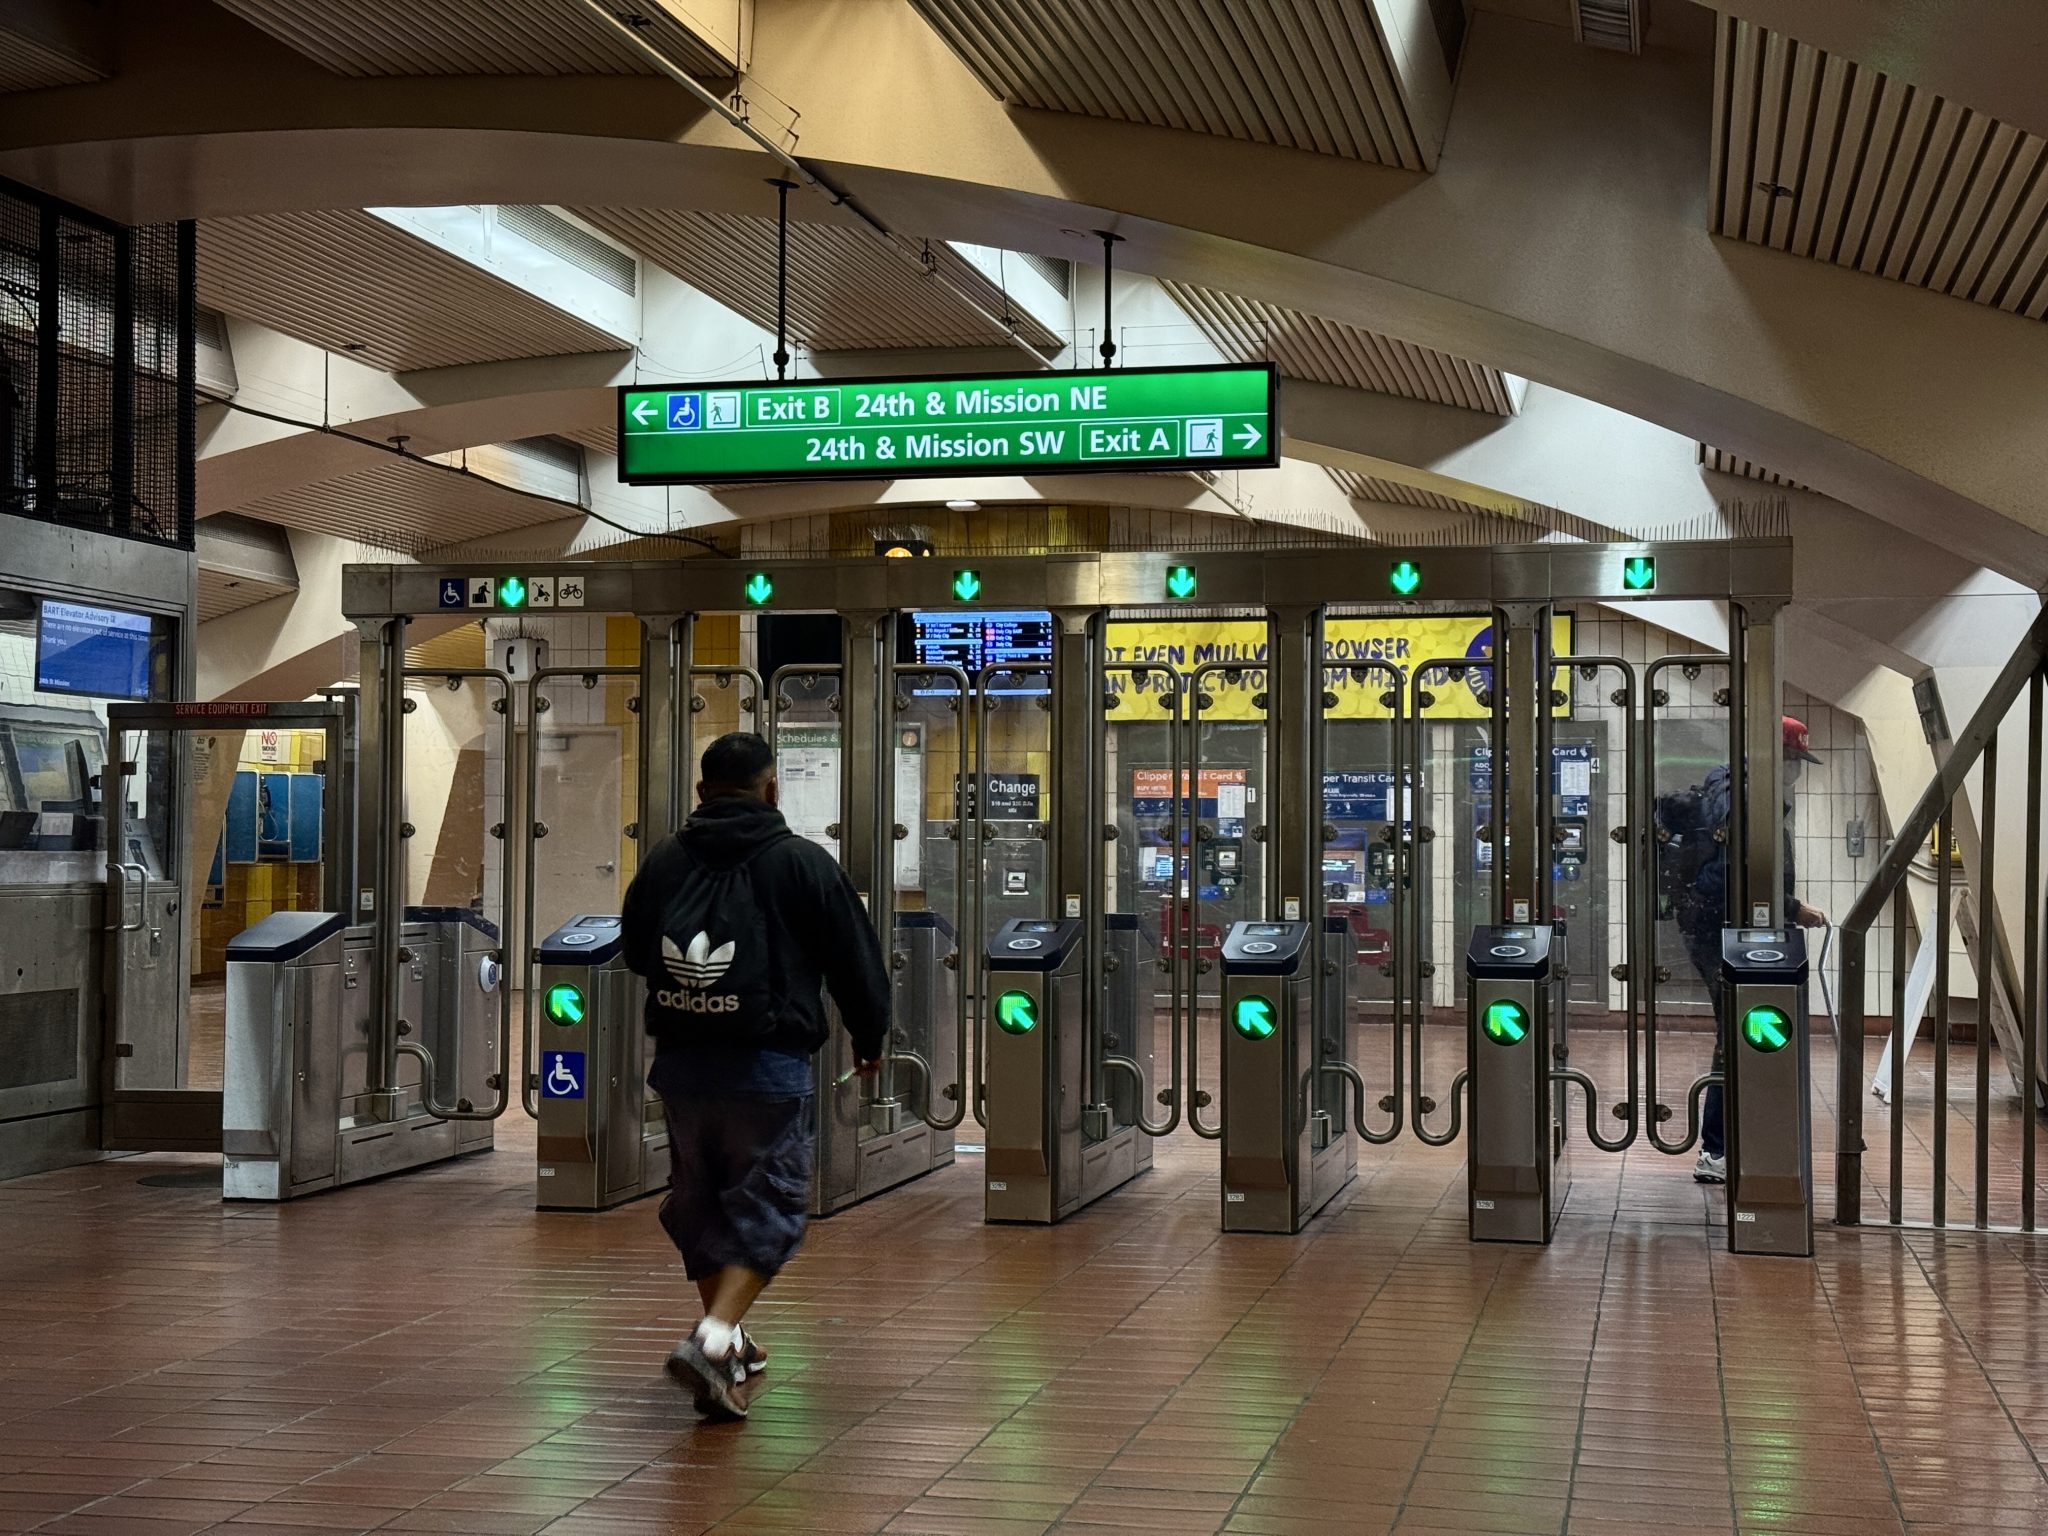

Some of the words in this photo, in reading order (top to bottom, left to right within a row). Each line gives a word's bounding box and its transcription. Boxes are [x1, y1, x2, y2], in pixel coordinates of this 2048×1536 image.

[758, 396, 806, 420] Exit
[814, 396, 830, 419] B
[855, 392, 915, 418] 24th
[925, 391, 946, 416] &
[955, 388, 1060, 415] Mission
[1070, 386, 1107, 411] NE
[806, 436, 865, 461] 24th
[875, 436, 897, 460] &
[906, 432, 1009, 459] Mission
[1019, 431, 1066, 456] SW
[1090, 427, 1141, 453] Exit
[1148, 427, 1170, 450] A
[43, 604, 59, 616] BART
[60, 608, 84, 620] Elevator
[85, 611, 109, 624] Advisory
[43, 619, 56, 629] There
[108, 630, 123, 639] service
[43, 634, 55, 643] Thank
[1134, 645, 1185, 665] EVEN
[1193, 643, 1267, 665] MULLV
[1323, 638, 1411, 658] ROWSER
[175, 703, 206, 715] SERVICE
[208, 703, 249, 715] EQUIPMENT
[251, 703, 267, 714] EXIT
[261, 731, 278, 746] NO
[777, 733, 828, 743] Schedules
[830, 733, 839, 742] &
[1552, 747, 1577, 756] Card
[1592, 759, 1599, 772] 4
[1137, 771, 1173, 782] Clipper
[1209, 772, 1233, 780] Card
[1342, 774, 1376, 783] Transit
[989, 780, 1036, 796] Change
[1249, 790, 1253, 801] 1
[657, 989, 740, 1013] adidas
